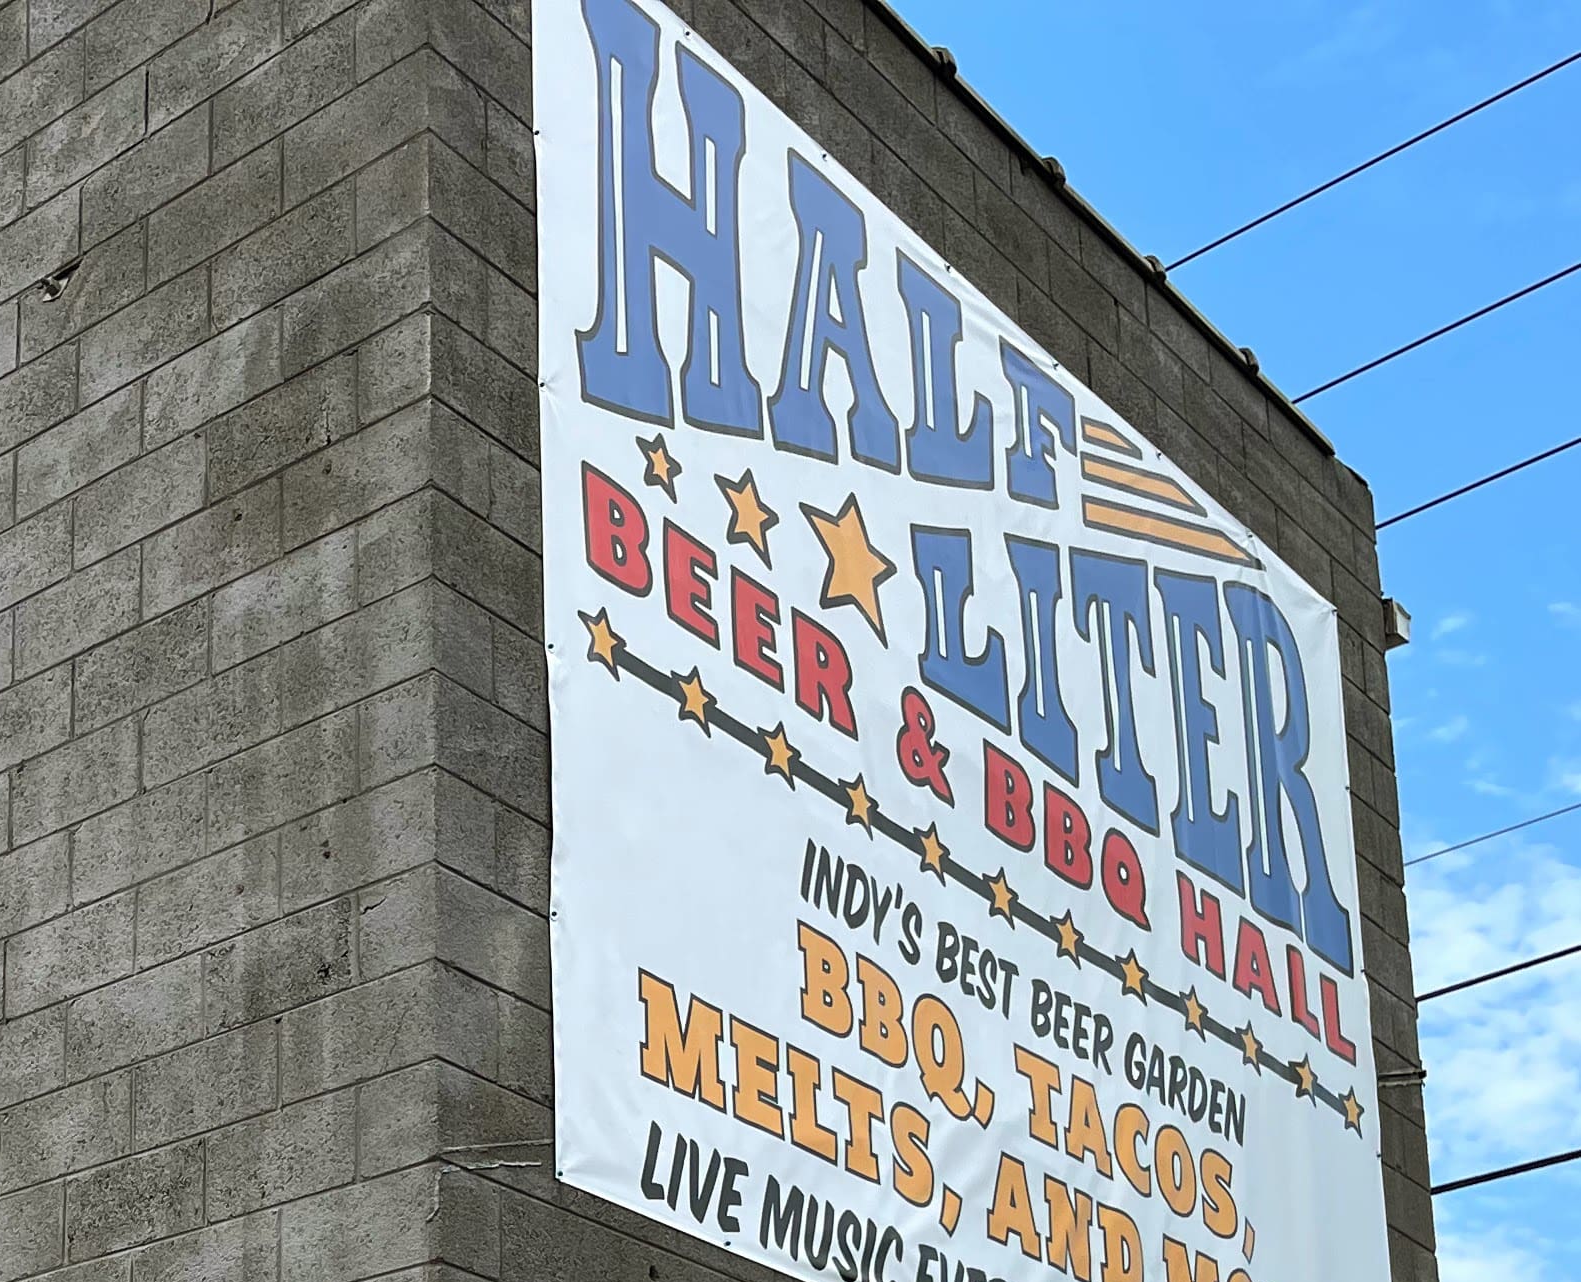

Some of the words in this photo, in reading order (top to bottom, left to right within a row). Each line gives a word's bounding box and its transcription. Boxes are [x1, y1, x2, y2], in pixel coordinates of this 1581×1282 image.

[575, 0, 1077, 510] HALF
[581, 460, 858, 741] BEER
[897, 686, 954, 808] &
[983, 738, 1151, 931] BBQ
[1176, 870, 1356, 1066] HALL
[909, 523, 1354, 978] LITER
[638, 967, 963, 1236] MELTS,
[797, 919, 995, 1130] BBQ,
[1013, 1043, 1256, 1264] TACOS,
[800, 838, 922, 965] INDY'S
[936, 922, 1019, 1018] BEST
[1031, 979, 1114, 1075] BEER
[1124, 1033, 1246, 1146] GARDEN
[640, 1120, 749, 1232] LIVE
